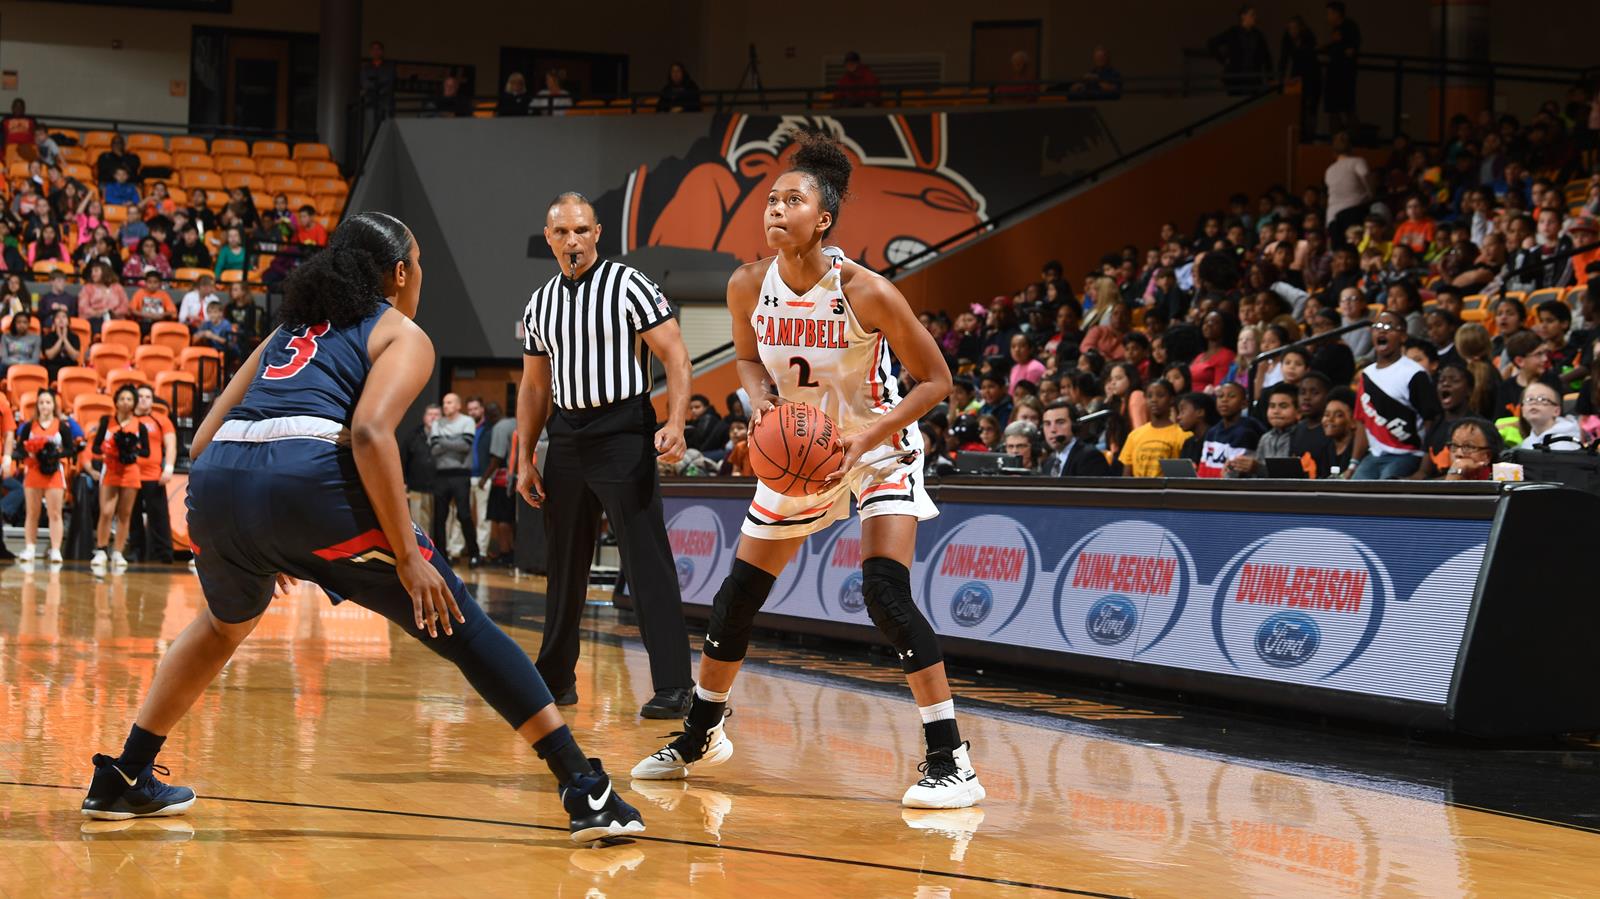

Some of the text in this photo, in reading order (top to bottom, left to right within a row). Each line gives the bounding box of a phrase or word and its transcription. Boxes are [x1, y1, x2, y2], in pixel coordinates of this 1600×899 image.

[261, 319, 331, 380] 3
[756, 314, 849, 349] CAMPBELL
[788, 356, 820, 388] 2
[940, 543, 1026, 583] DUNN-BENSON
[1071, 550, 1178, 597] DUNN-BENSON
[955, 588, 987, 619] Ford
[1235, 561, 1370, 614] DUNN-BENSON
[1092, 603, 1131, 637] Ford
[1263, 620, 1311, 657] Ford
